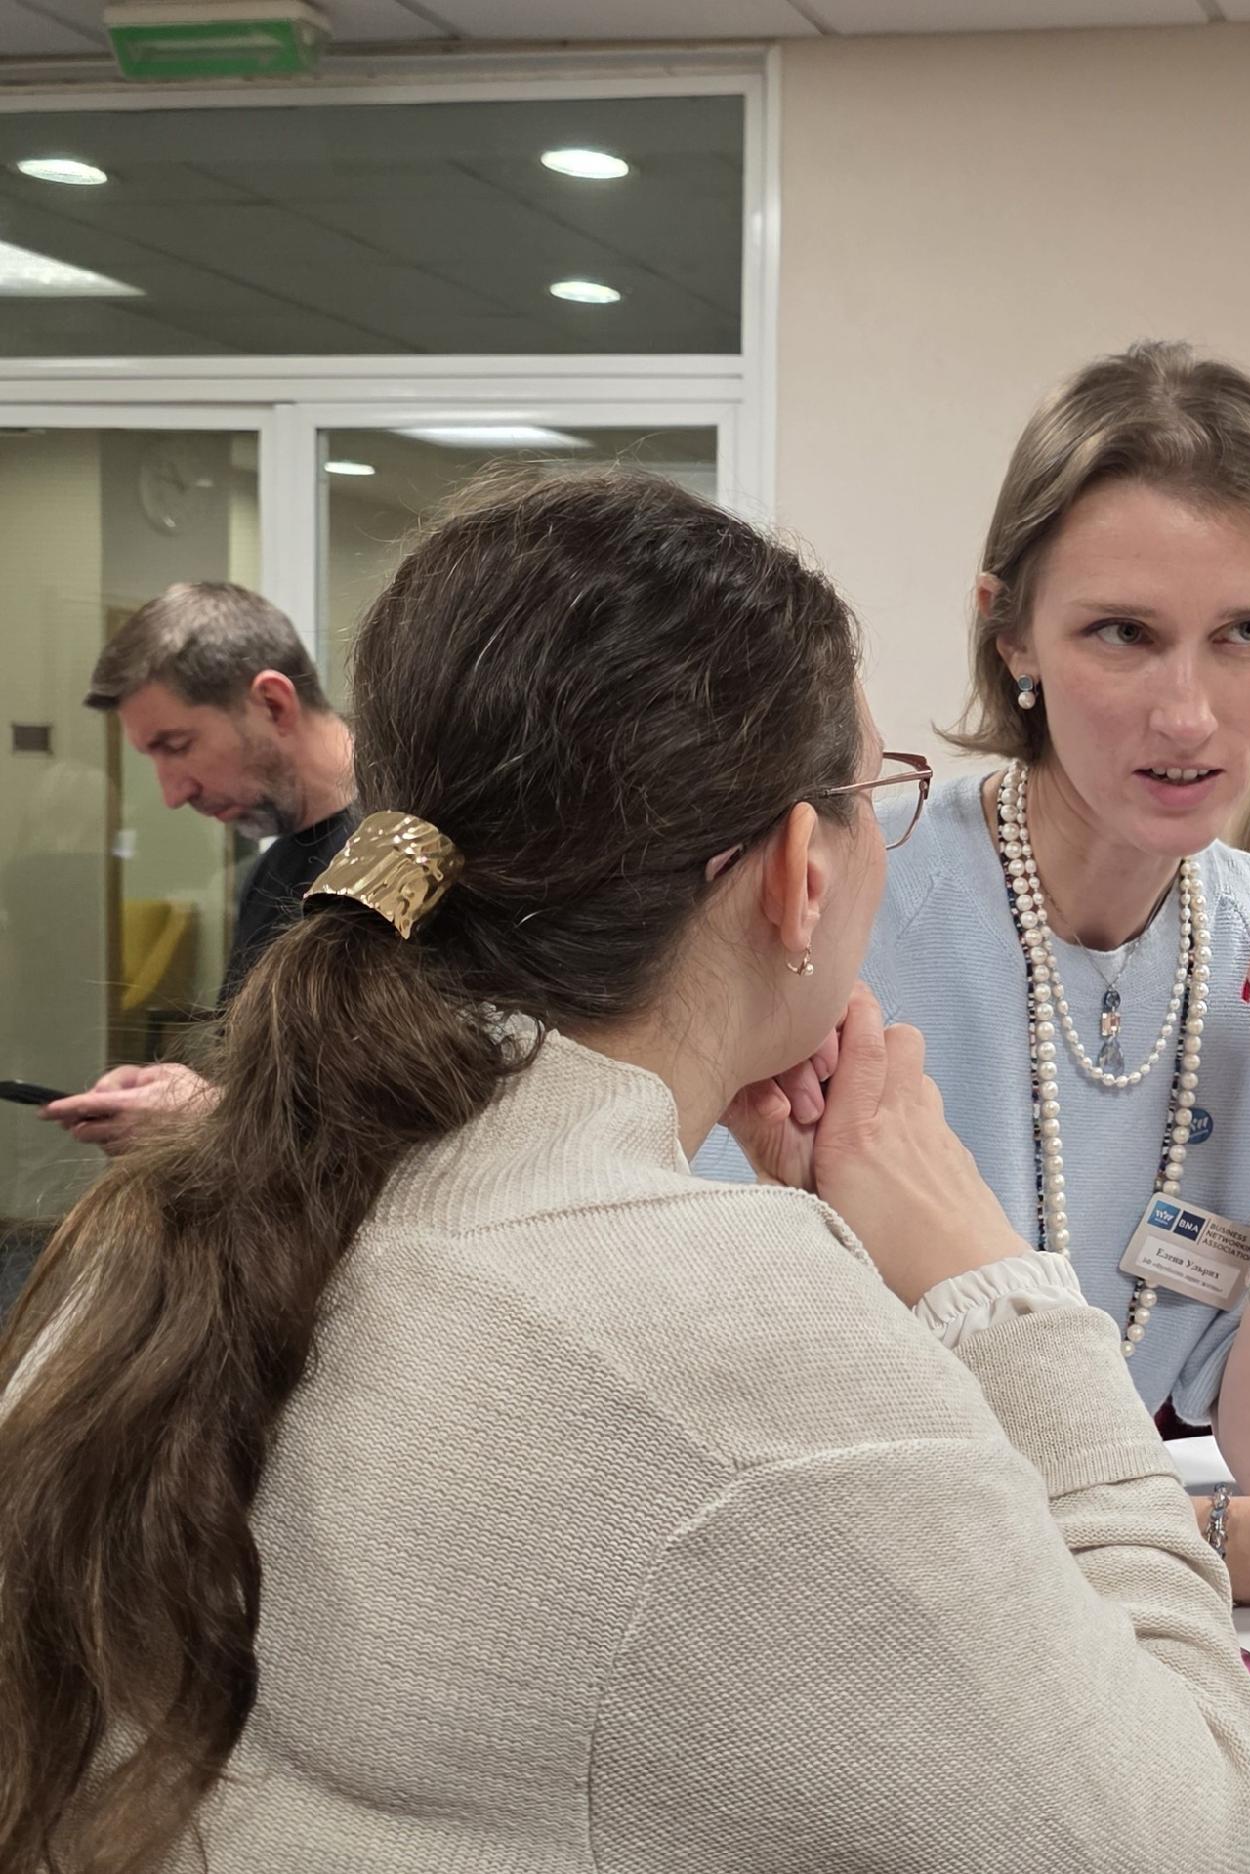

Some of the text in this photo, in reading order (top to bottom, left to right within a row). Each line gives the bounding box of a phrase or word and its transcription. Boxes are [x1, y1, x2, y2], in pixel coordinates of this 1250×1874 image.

[1178, 1217, 1199, 1233] BNA
[1210, 1223, 1247, 1242] BUSINESS
[1202, 1238, 1250, 1260] ASSOCIATIO
